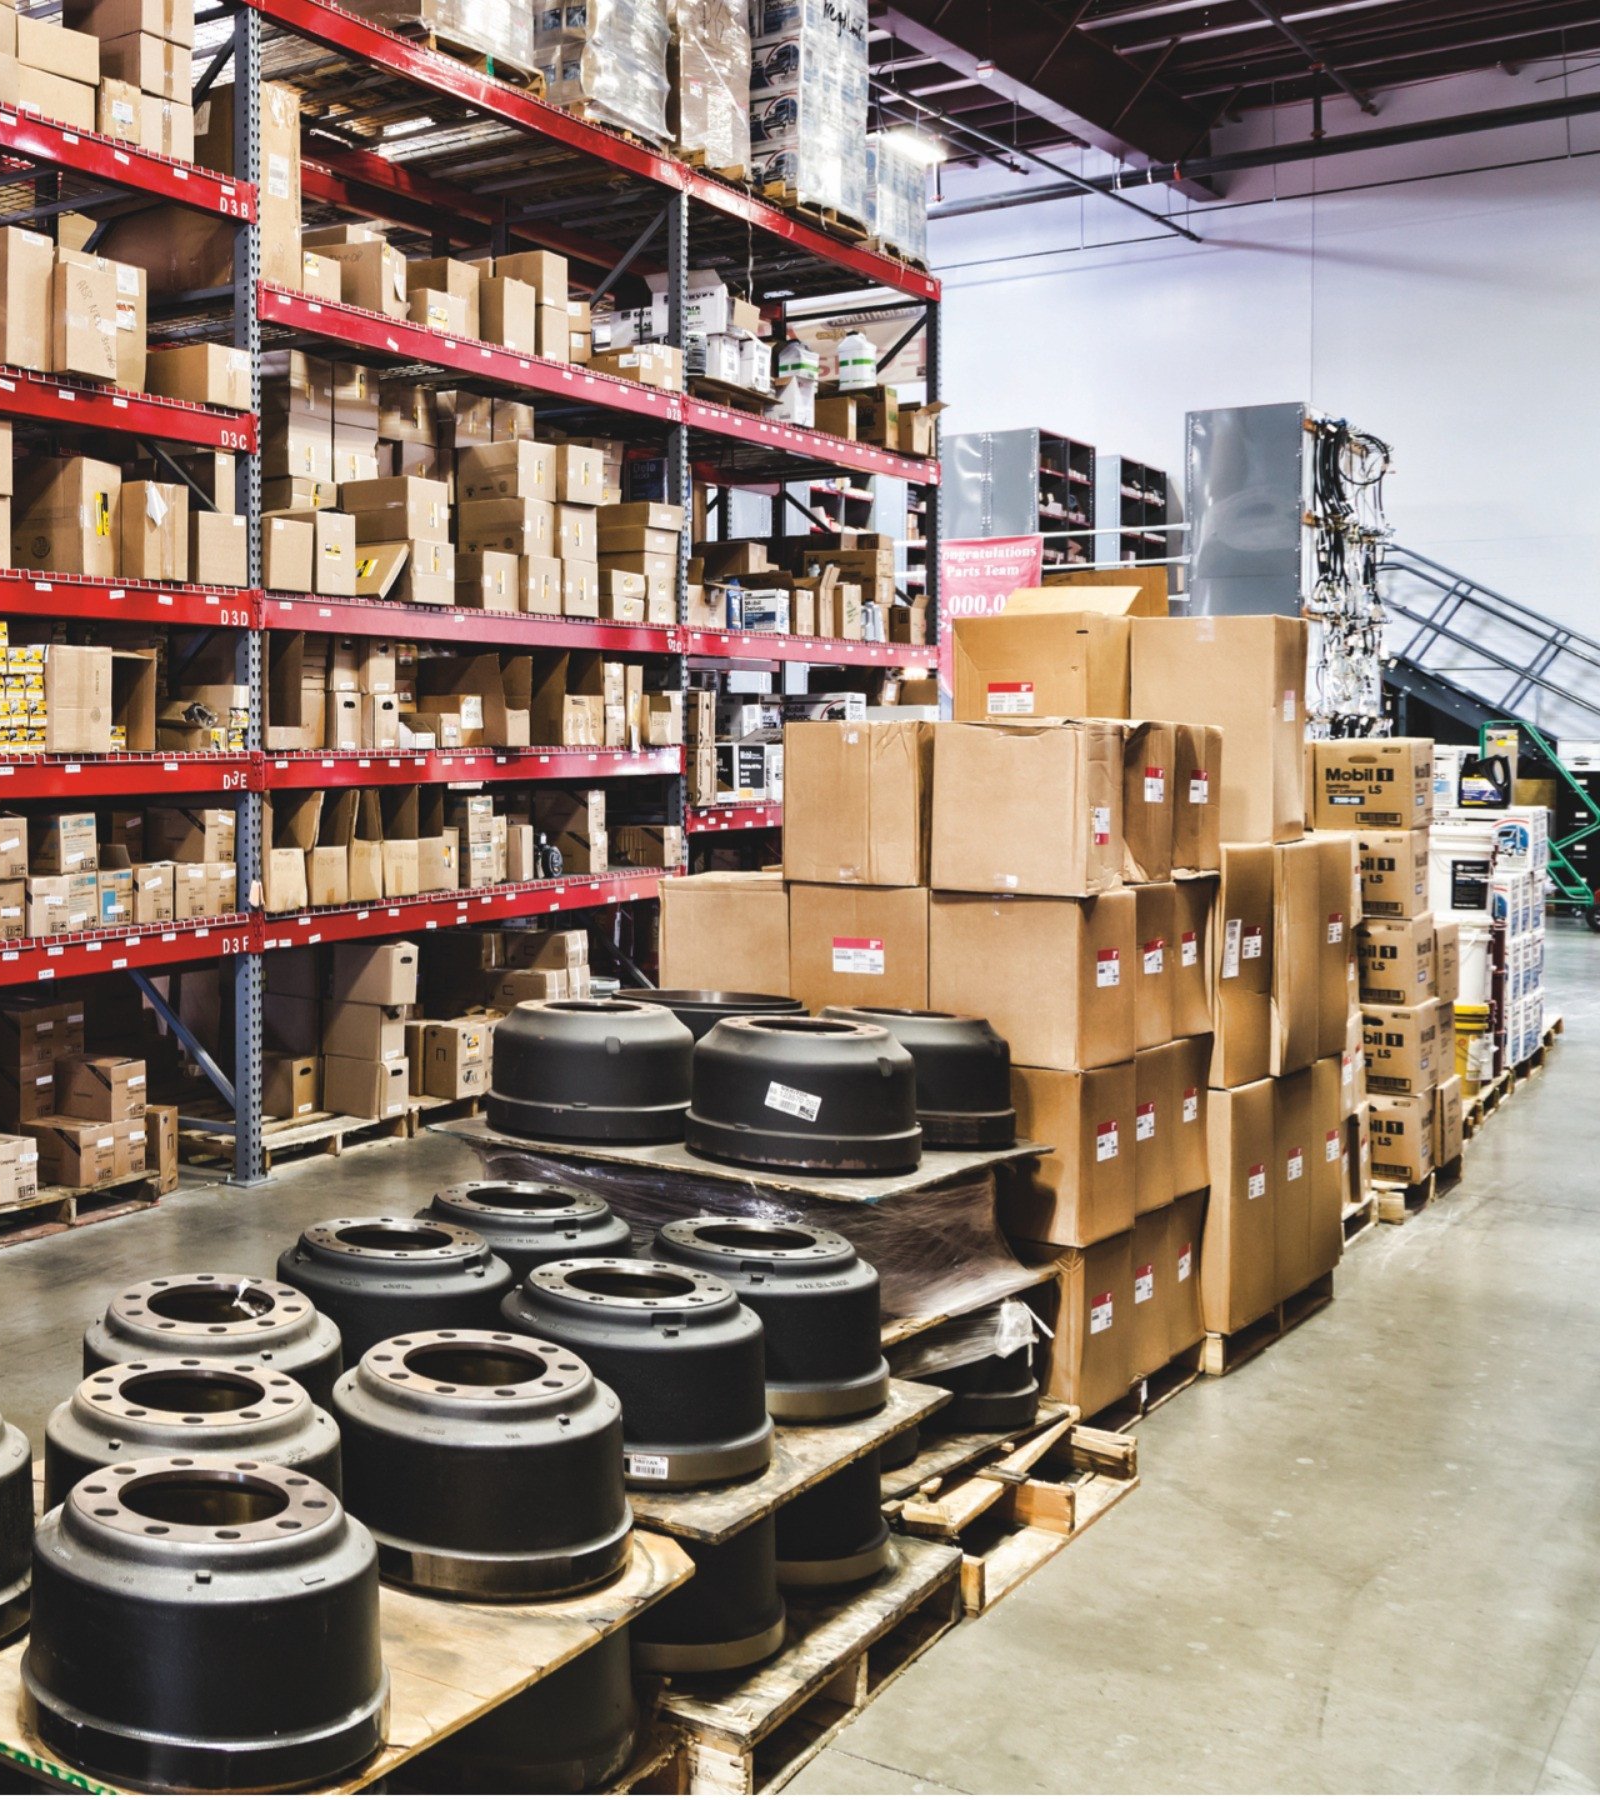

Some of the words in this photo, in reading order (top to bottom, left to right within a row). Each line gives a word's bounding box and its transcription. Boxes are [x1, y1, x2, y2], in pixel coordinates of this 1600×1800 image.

[220, 430, 248, 450] D3C
[941, 546, 1038, 563] ongratulations
[946, 565, 980, 577] Parts
[983, 564, 1020, 577] Team
[220, 609, 249, 626] D3D
[223, 770, 248, 789] D3E
[1325, 768, 1373, 781] Mobil
[1368, 785, 1382, 795] LS
[1369, 874, 1383, 884] LS
[222, 936, 249, 954] D3F
[1371, 961, 1386, 971] LS
[1377, 1049, 1391, 1059] LS
[1377, 1137, 1392, 1147] LS
